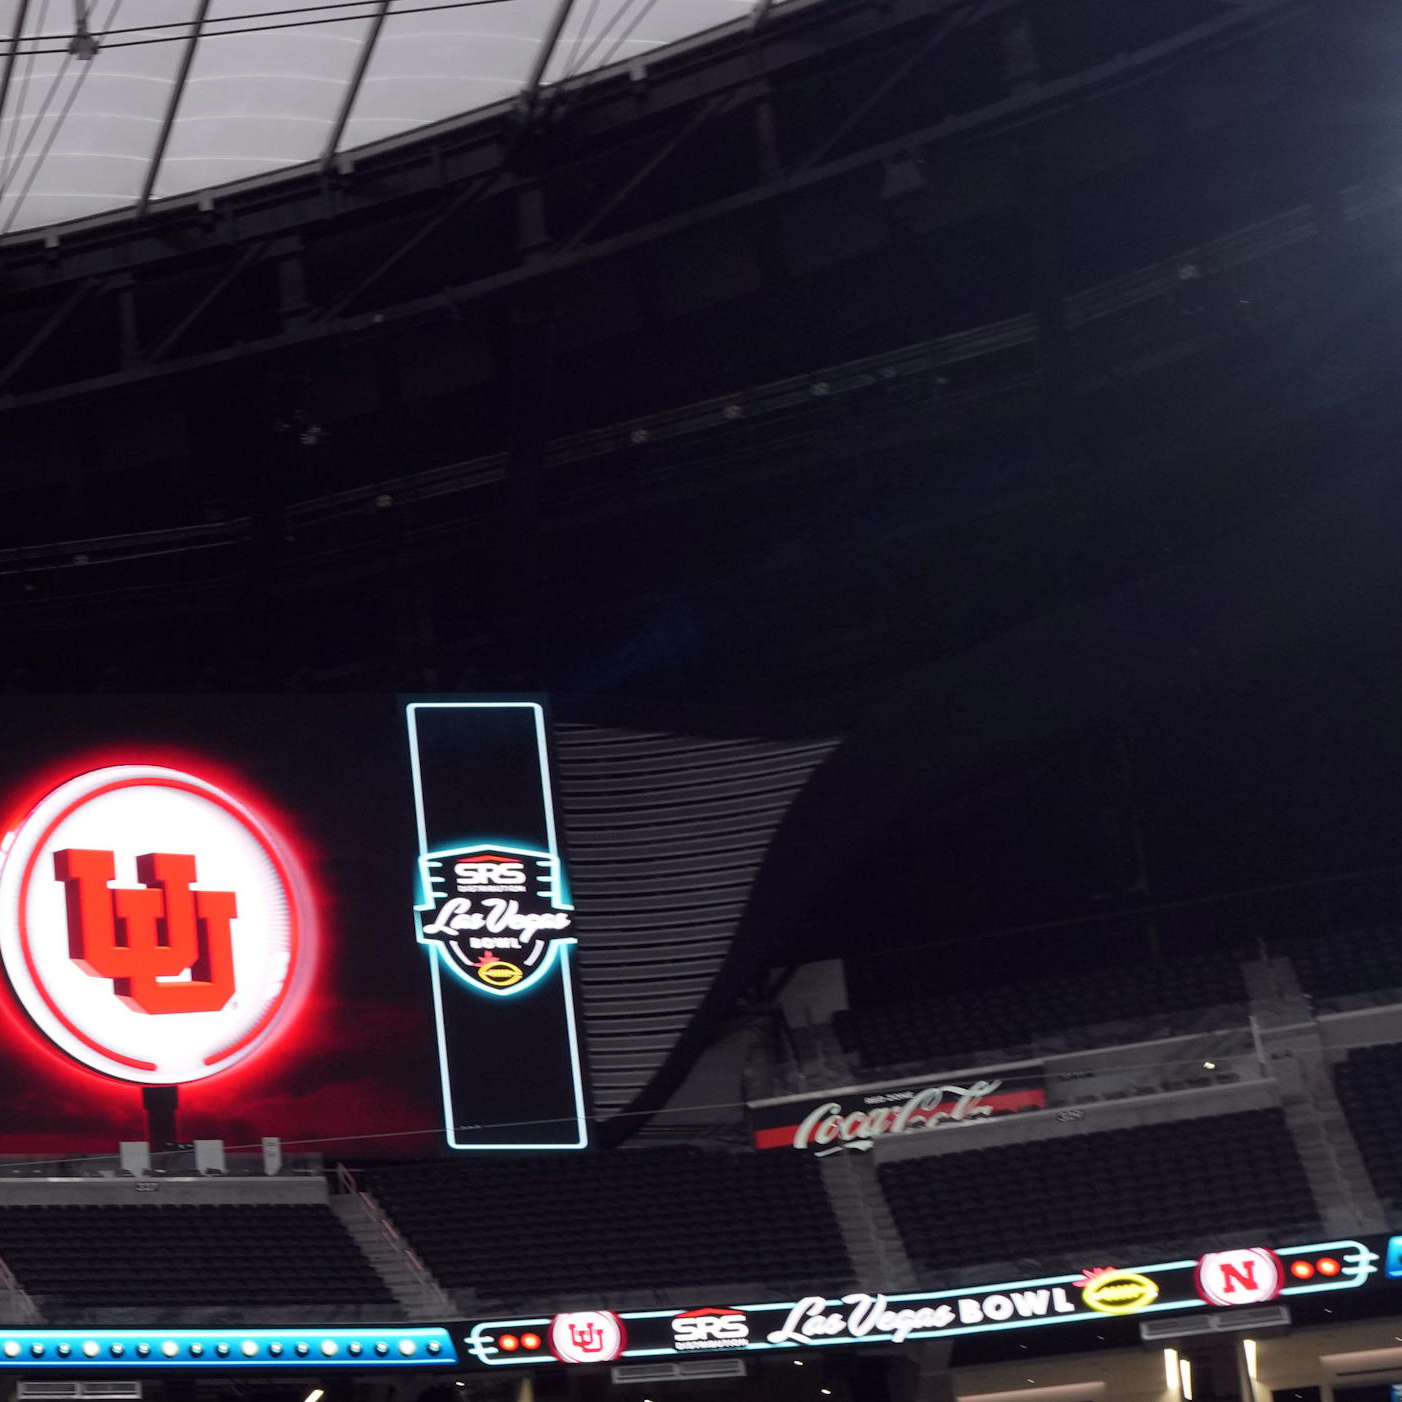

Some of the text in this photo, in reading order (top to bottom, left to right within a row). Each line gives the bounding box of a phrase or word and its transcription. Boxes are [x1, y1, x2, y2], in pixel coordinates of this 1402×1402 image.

[454, 862, 526, 885] SRS
[423, 897, 571, 943] Las Vegas
[1220, 1261, 1261, 1294] N
[671, 1314, 749, 1342] SRS
[766, 1287, 1075, 1345] Las Vegas BOWL
